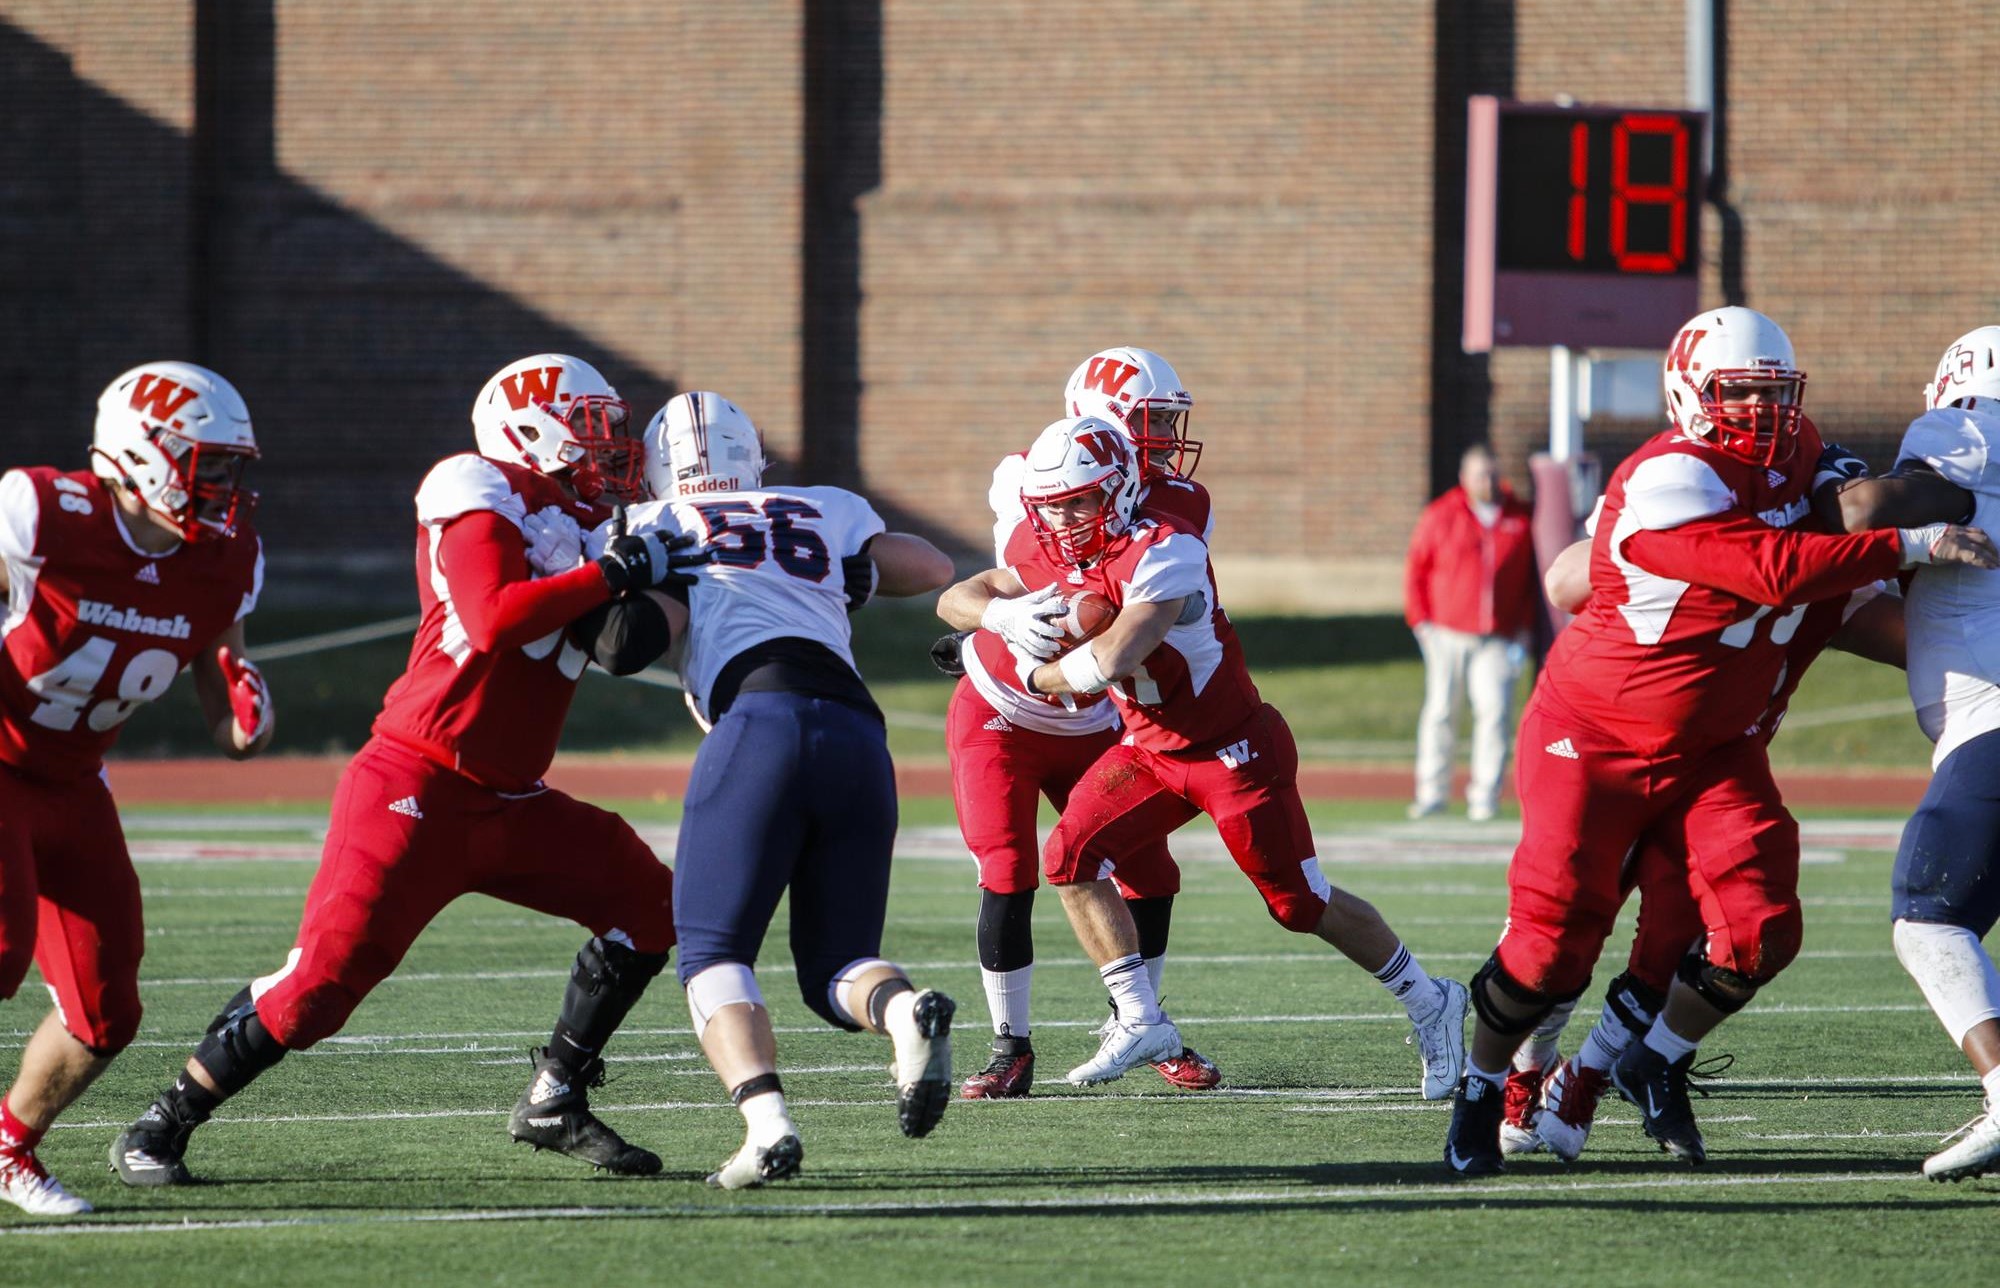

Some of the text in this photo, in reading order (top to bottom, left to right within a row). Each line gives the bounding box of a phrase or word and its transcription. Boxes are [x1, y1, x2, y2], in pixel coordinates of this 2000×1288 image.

[1568, 114, 1689, 273] 18
[679, 477, 740, 496] Riddell
[693, 497, 831, 584] 56
[77, 599, 192, 639] Wabash
[27, 635, 180, 732] 48
[1545, 745, 1579, 760] adidas
[388, 803, 424, 819] adidas
[530, 1083, 570, 1105] adidas
